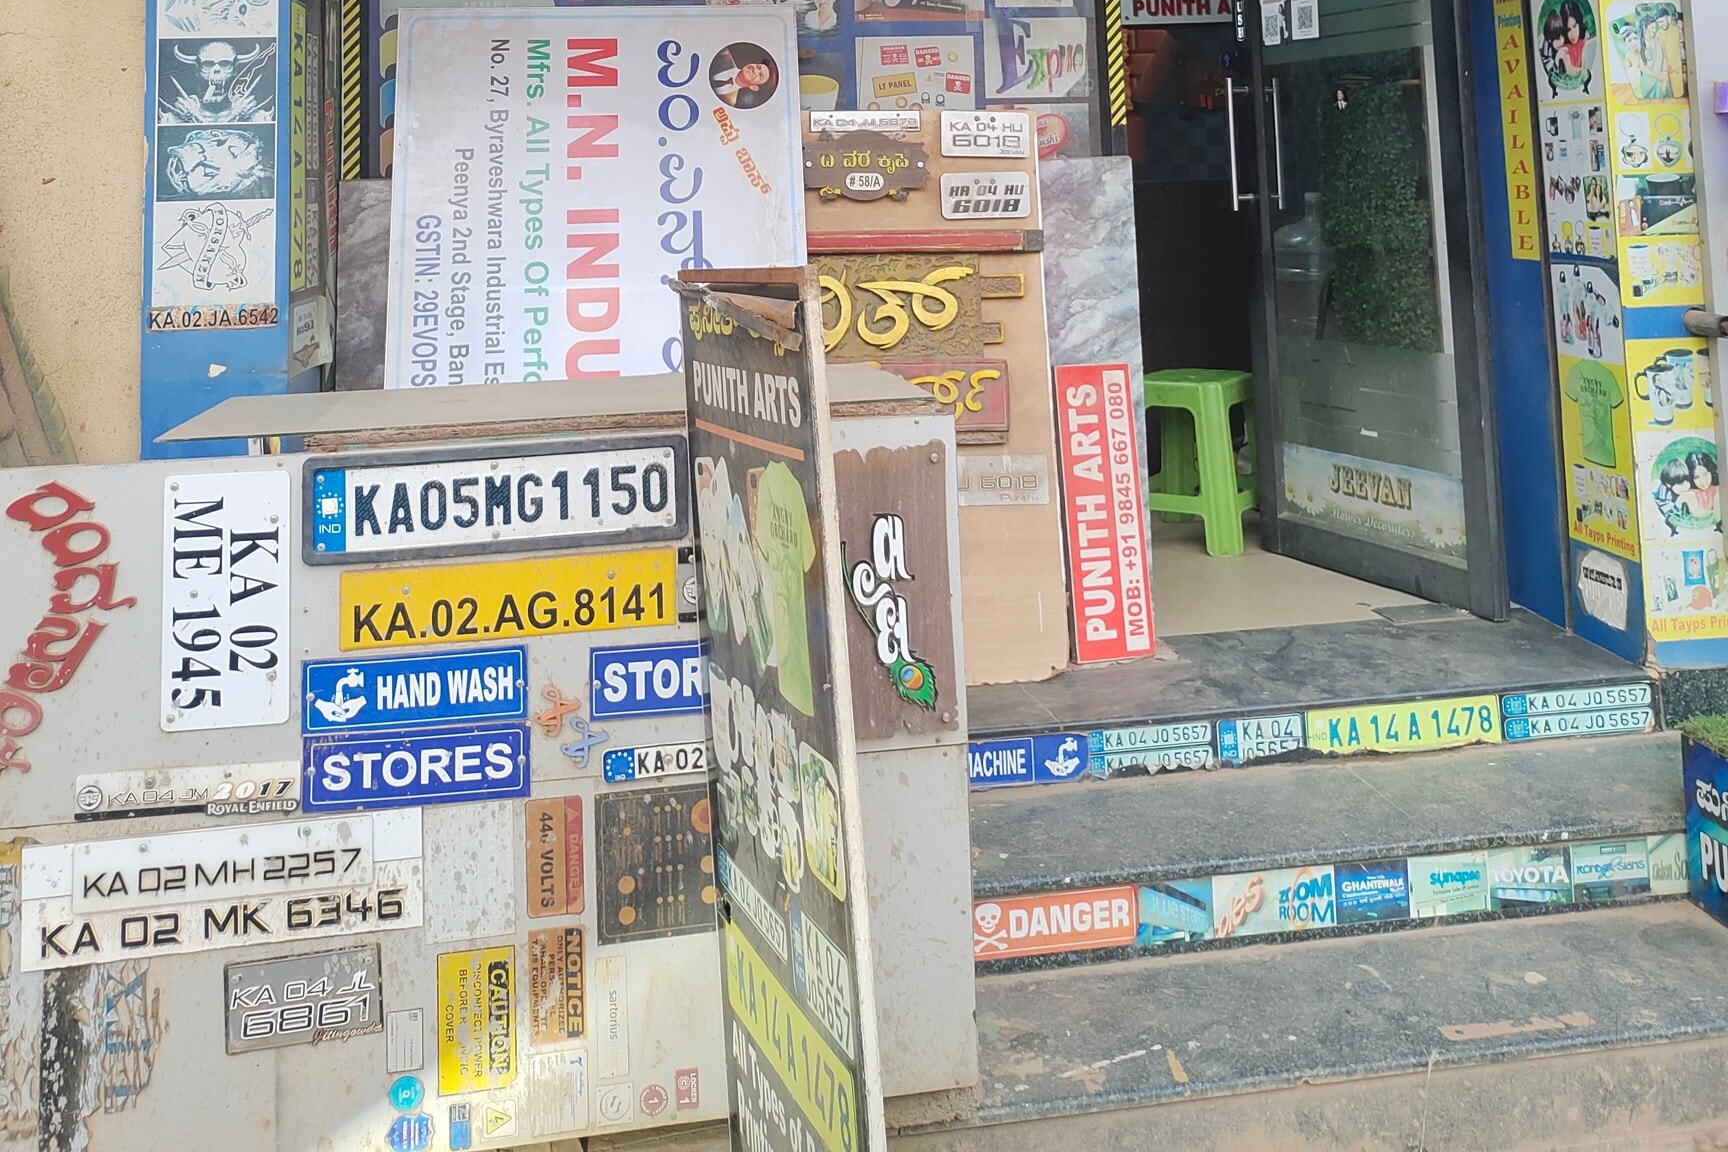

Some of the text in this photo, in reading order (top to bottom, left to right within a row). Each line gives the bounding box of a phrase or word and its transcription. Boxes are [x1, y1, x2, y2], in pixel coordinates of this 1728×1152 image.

[889, 79, 912, 90] PANEL
[949, 120, 1023, 133] KA 04 HU
[953, 134, 1021, 148] 6018
[449, 148, 475, 222] Peenya
[518, 39, 551, 298] Mfrs. All Types Of
[858, 174, 881, 188] 58/A
[976, 184, 998, 197] 04
[484, 38, 512, 356] No. 27, Byraveshwara Industrial
[564, 38, 622, 379] M.N. INDU
[952, 198, 1022, 214] 6018
[415, 214, 442, 285] GSTIN:
[450, 226, 473, 265] 2nd
[149, 306, 280, 332] KA.02.JA.6542
[444, 270, 473, 338] Stage,
[693, 359, 801, 428] PUNITH ARTS
[354, 461, 669, 537] KA05MG1150
[979, 474, 1039, 490] 6018
[1328, 462, 1413, 511] JEEVAN
[318, 523, 342, 534] IND
[1066, 383, 1119, 642] PUNITH ARTS
[1107, 381, 1146, 636] MOB: +91 9845 667 080
[1573, 520, 1636, 557] All Tayps Printing
[171, 495, 225, 710] ME 1945
[229, 526, 280, 673] KA 02
[353, 582, 665, 643] KA.02.AG.8141
[1652, 618, 1707, 634] All Tayps
[377, 664, 514, 711] HAND WASH
[602, 658, 701, 703] STOR
[1528, 693, 1577, 712] KA 04
[1104, 729, 1148, 748] KA 04
[1242, 718, 1294, 740] KA 04
[1328, 704, 1494, 748] KA 14 A 1478
[1531, 715, 1580, 735] KA 04
[322, 741, 513, 792] STORES
[638, 746, 704, 776] KA 02
[107, 791, 140, 805] KA
[142, 788, 175, 802] 04
[212, 779, 295, 798] 2017
[83, 847, 363, 899] KA 02 MH 2257
[540, 848, 555, 909] VOLTS
[1495, 865, 1570, 884] TOYOTA
[40, 884, 409, 959] KA 02 MK 6346
[1008, 898, 1131, 939] DANGER
[1278, 900, 1335, 925] ROOM
[556, 934, 565, 963] ONLY
[231, 984, 277, 1011] KA
[283, 977, 330, 1002] 04
[567, 933, 582, 1033] NOTICE
[737, 944, 758, 1026] KA
[761, 979, 782, 1060] 14
[240, 993, 372, 1042] 6861
[445, 1004, 455, 1043] COVER
[489, 968, 508, 1069] CAUTION
[608, 989, 619, 1041] sartorius
[690, 1072, 698, 1104] LOCKER
[732, 1020, 787, 1137] All Types
